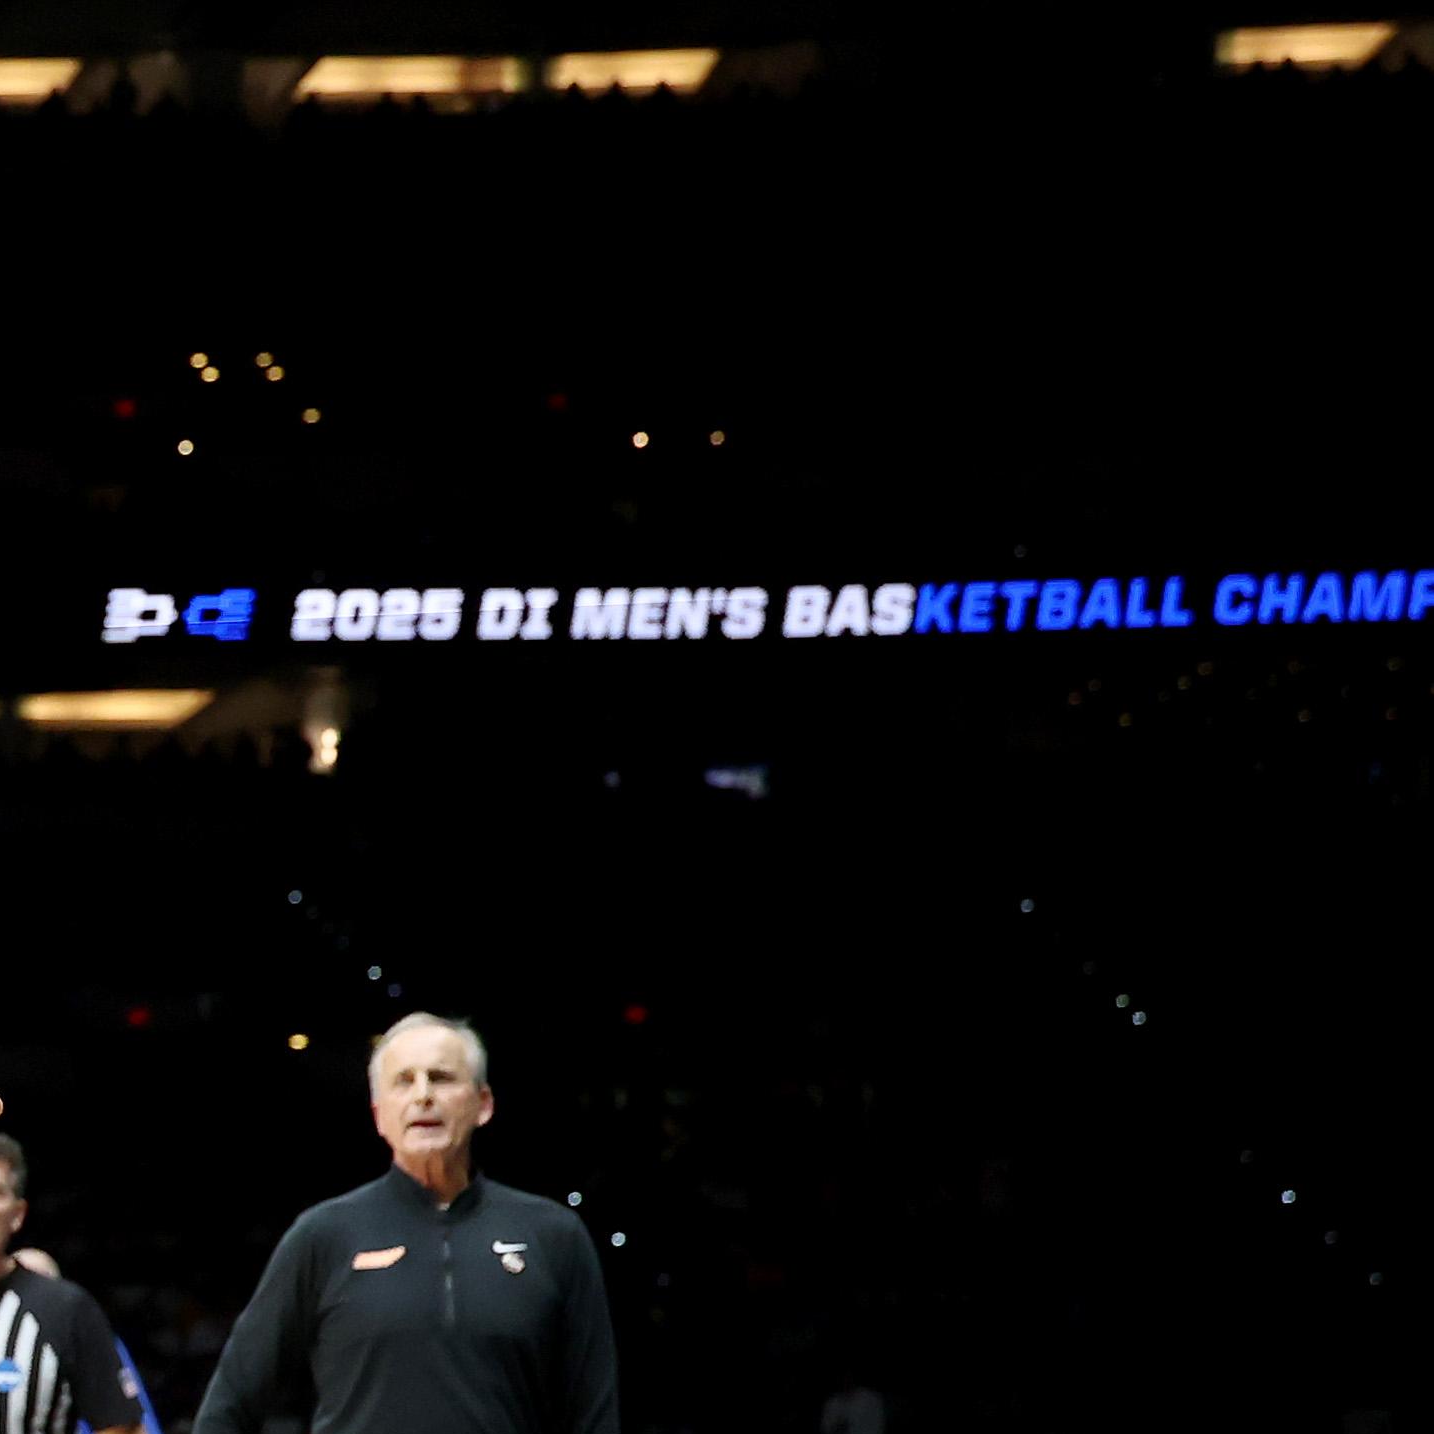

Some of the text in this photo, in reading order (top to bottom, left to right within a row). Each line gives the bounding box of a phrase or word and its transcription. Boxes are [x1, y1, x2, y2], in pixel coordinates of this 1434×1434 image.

[290, 588, 464, 641] 2025
[476, 587, 559, 641] DI
[568, 586, 768, 641] MEN'S
[782, 575, 1193, 638] BASKETBALL
